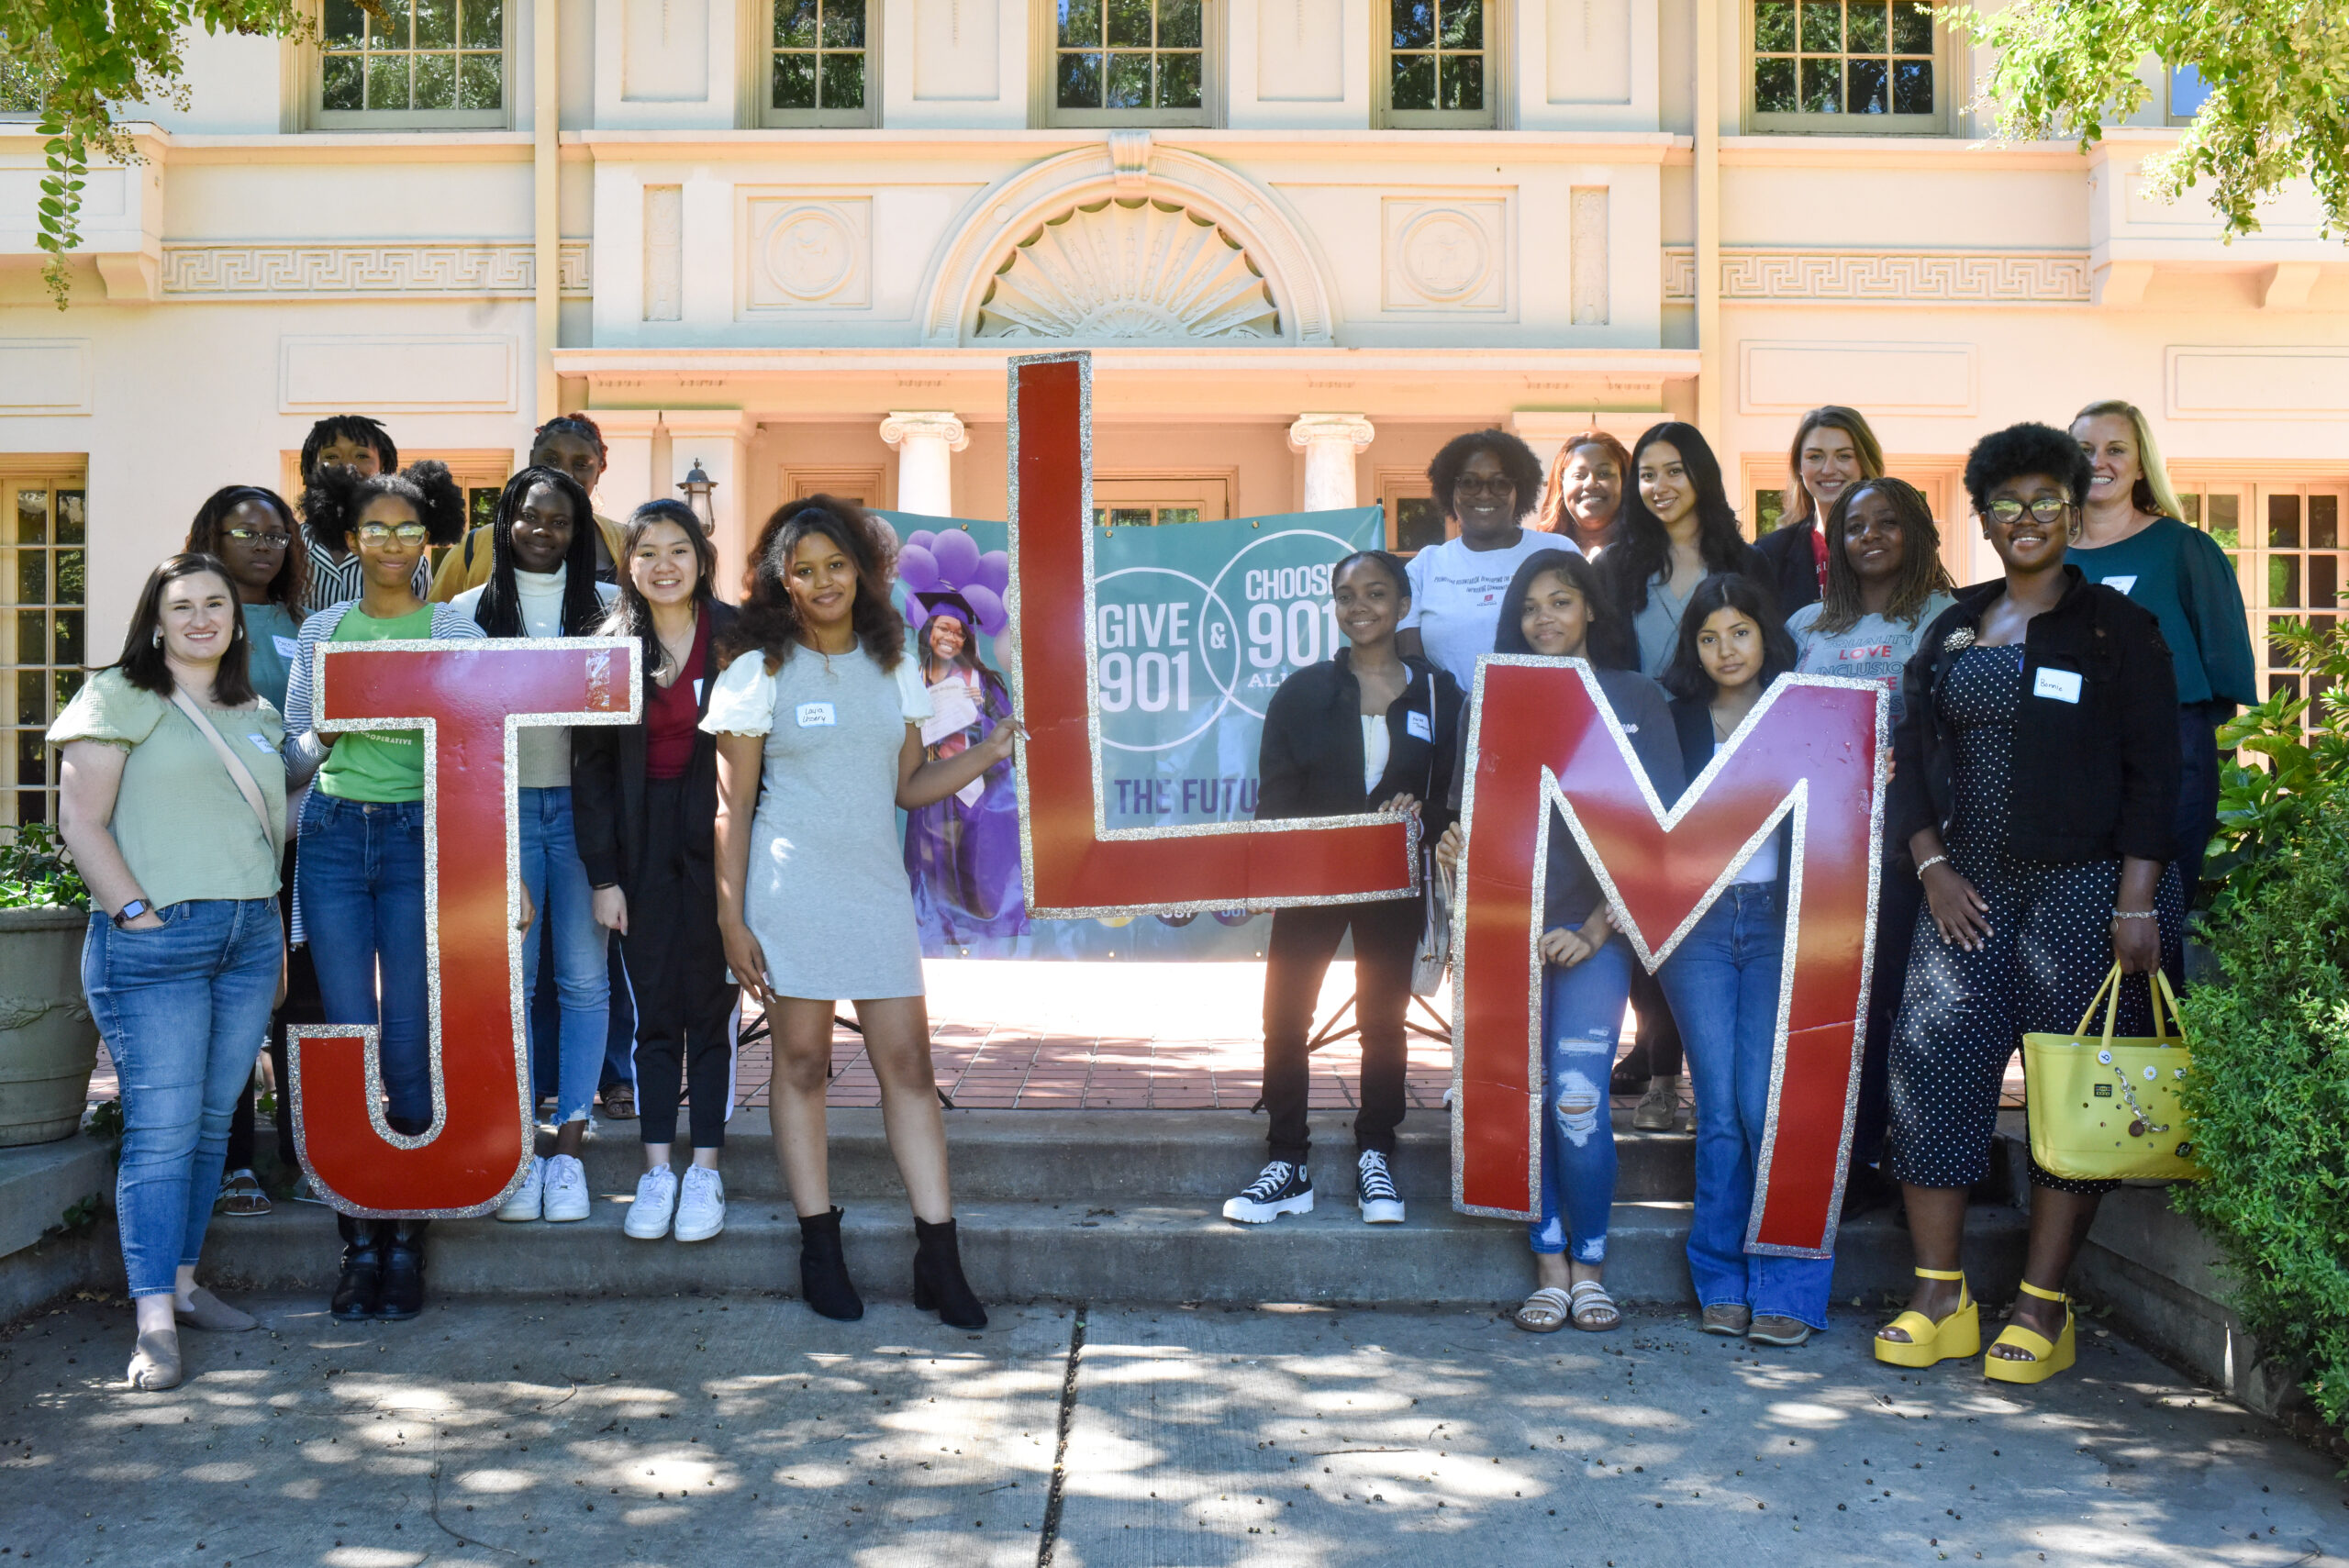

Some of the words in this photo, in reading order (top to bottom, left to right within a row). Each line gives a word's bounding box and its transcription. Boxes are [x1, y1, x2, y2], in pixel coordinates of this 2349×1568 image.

[1097, 602, 1189, 649] GIVE
[1209, 622, 1228, 650] &
[1248, 599, 1340, 669] 901
[1816, 661, 1904, 678] INCLUSIO
[1839, 645, 1893, 661] LOVE
[1098, 651, 1189, 713] 901
[286, 636, 642, 1218] J
[1007, 350, 1419, 918] L
[1452, 653, 1890, 1259] M
[1114, 778, 1172, 814] THE
[1182, 778, 1259, 814] FUTU
